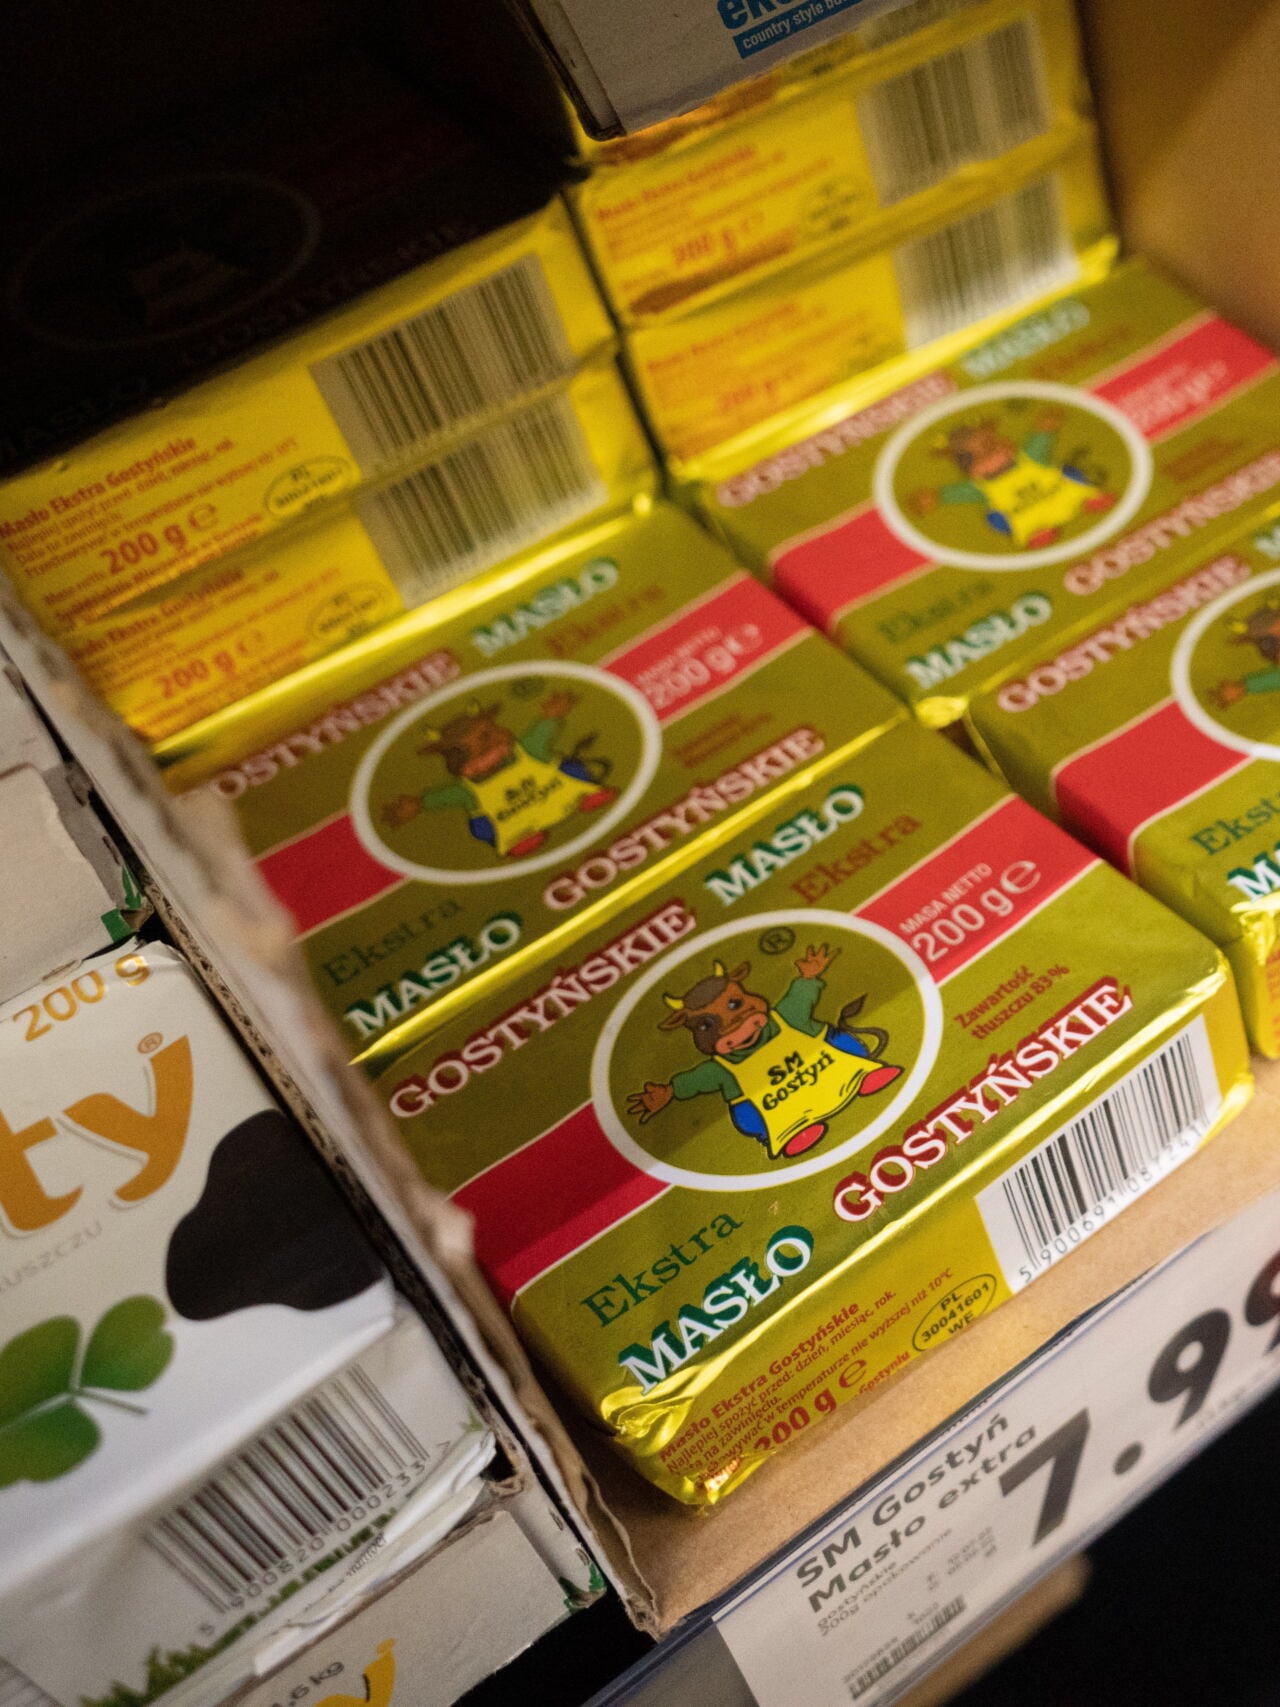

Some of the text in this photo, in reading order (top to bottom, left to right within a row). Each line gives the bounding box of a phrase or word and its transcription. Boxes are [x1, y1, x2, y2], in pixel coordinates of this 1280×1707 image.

[742, 18, 792, 50] country
[792, 2, 825, 26] style
[100, 531, 160, 576] 200
[905, 590, 1052, 690] MASŁO
[206, 650, 460, 800] OSTYŃSKIE
[543, 727, 826, 911] GOSTYŃSKIE
[704, 784, 864, 906] MASŁO
[789, 814, 924, 906] Ekstra
[899, 862, 993, 935] MASA NETTO
[912, 902, 986, 963] 200
[12, 951, 153, 1042] 200 g
[343, 912, 524, 1040] MASŁO
[389, 899, 698, 1119] GOSTYŃSKIE
[954, 965, 1036, 1031] Zawartość
[970, 991, 1035, 1041] tłuszczu
[768, 1051, 805, 1086] SM
[833, 974, 1134, 1223] GOSTYŃSKIE
[580, 1213, 744, 1328] Ekstra
[618, 1225, 814, 1396] MASŁO
[920, 1281, 991, 1343] 30041601
[940, 1292, 963, 1312] PL
[660, 1302, 859, 1464] Masło Ekstra Gostyńskie
[753, 1406, 811, 1452] 200
[814, 1387, 838, 1414] g
[775, 1354, 851, 1419] temperaturze
[850, 1336, 869, 1356] nie
[666, 1428, 719, 1474] Najlepiej
[703, 1444, 721, 1461] na
[796, 1525, 863, 1589] SM
[872, 1412, 1010, 1527] Gostyń
[808, 1514, 926, 1614] Masło
[937, 1424, 1037, 1511] extra
